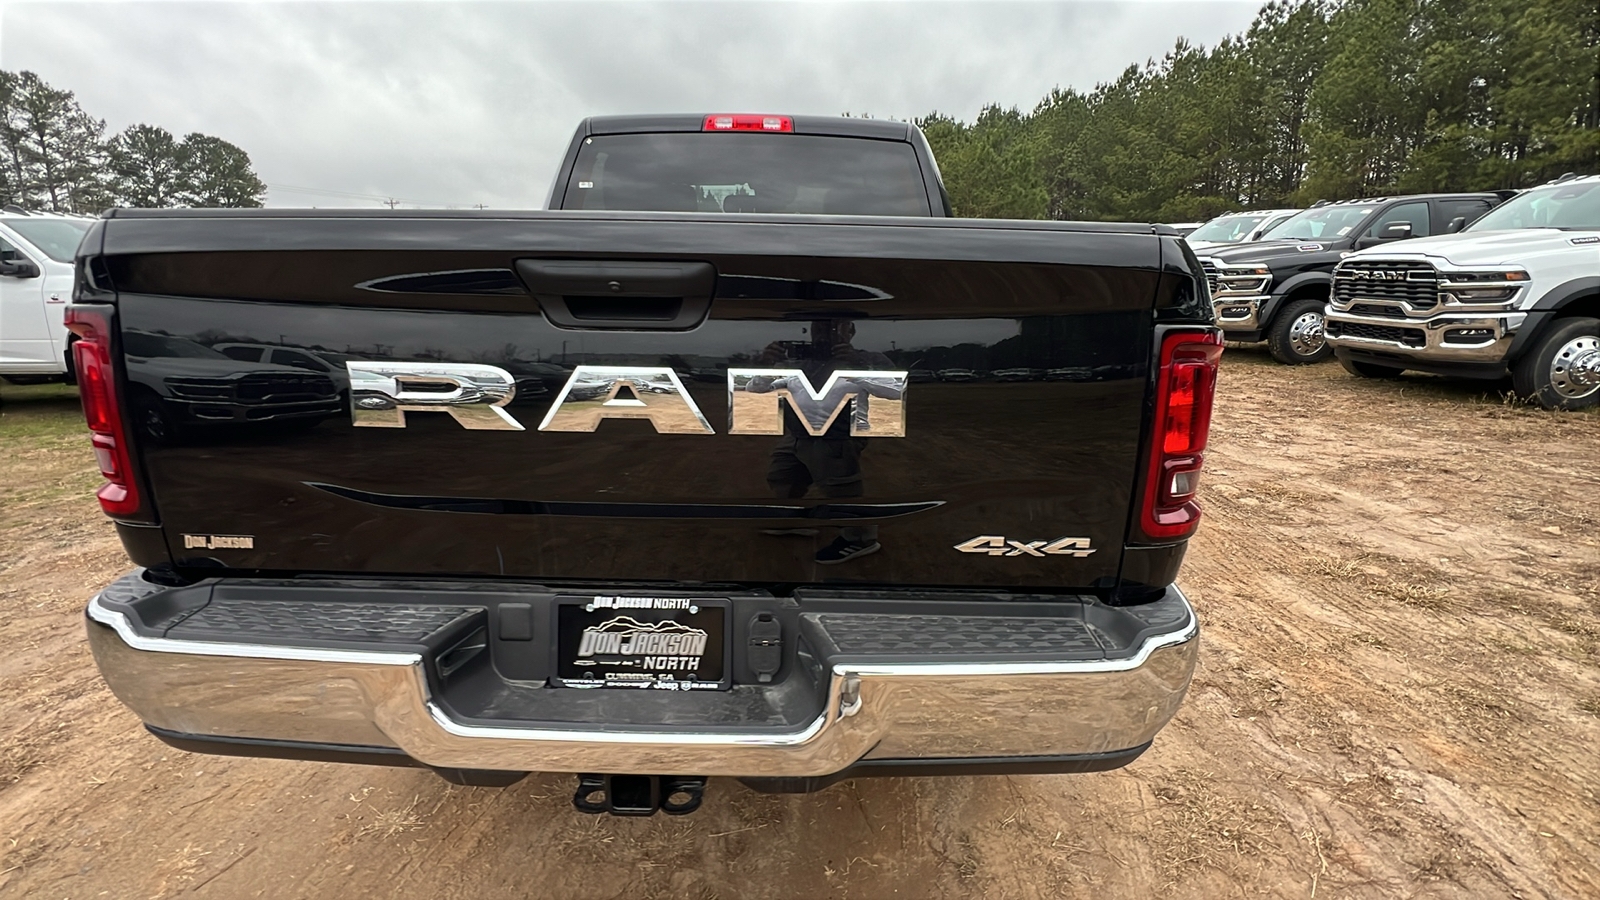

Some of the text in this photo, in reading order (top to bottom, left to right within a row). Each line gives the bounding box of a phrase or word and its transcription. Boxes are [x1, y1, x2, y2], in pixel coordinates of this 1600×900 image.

[1353, 270, 1406, 280] RAM
[346, 360, 909, 437] RAM
[653, 598, 691, 610] NORTH
[577, 631, 708, 657] DON JACKSON
[643, 656, 701, 671] NORTH
